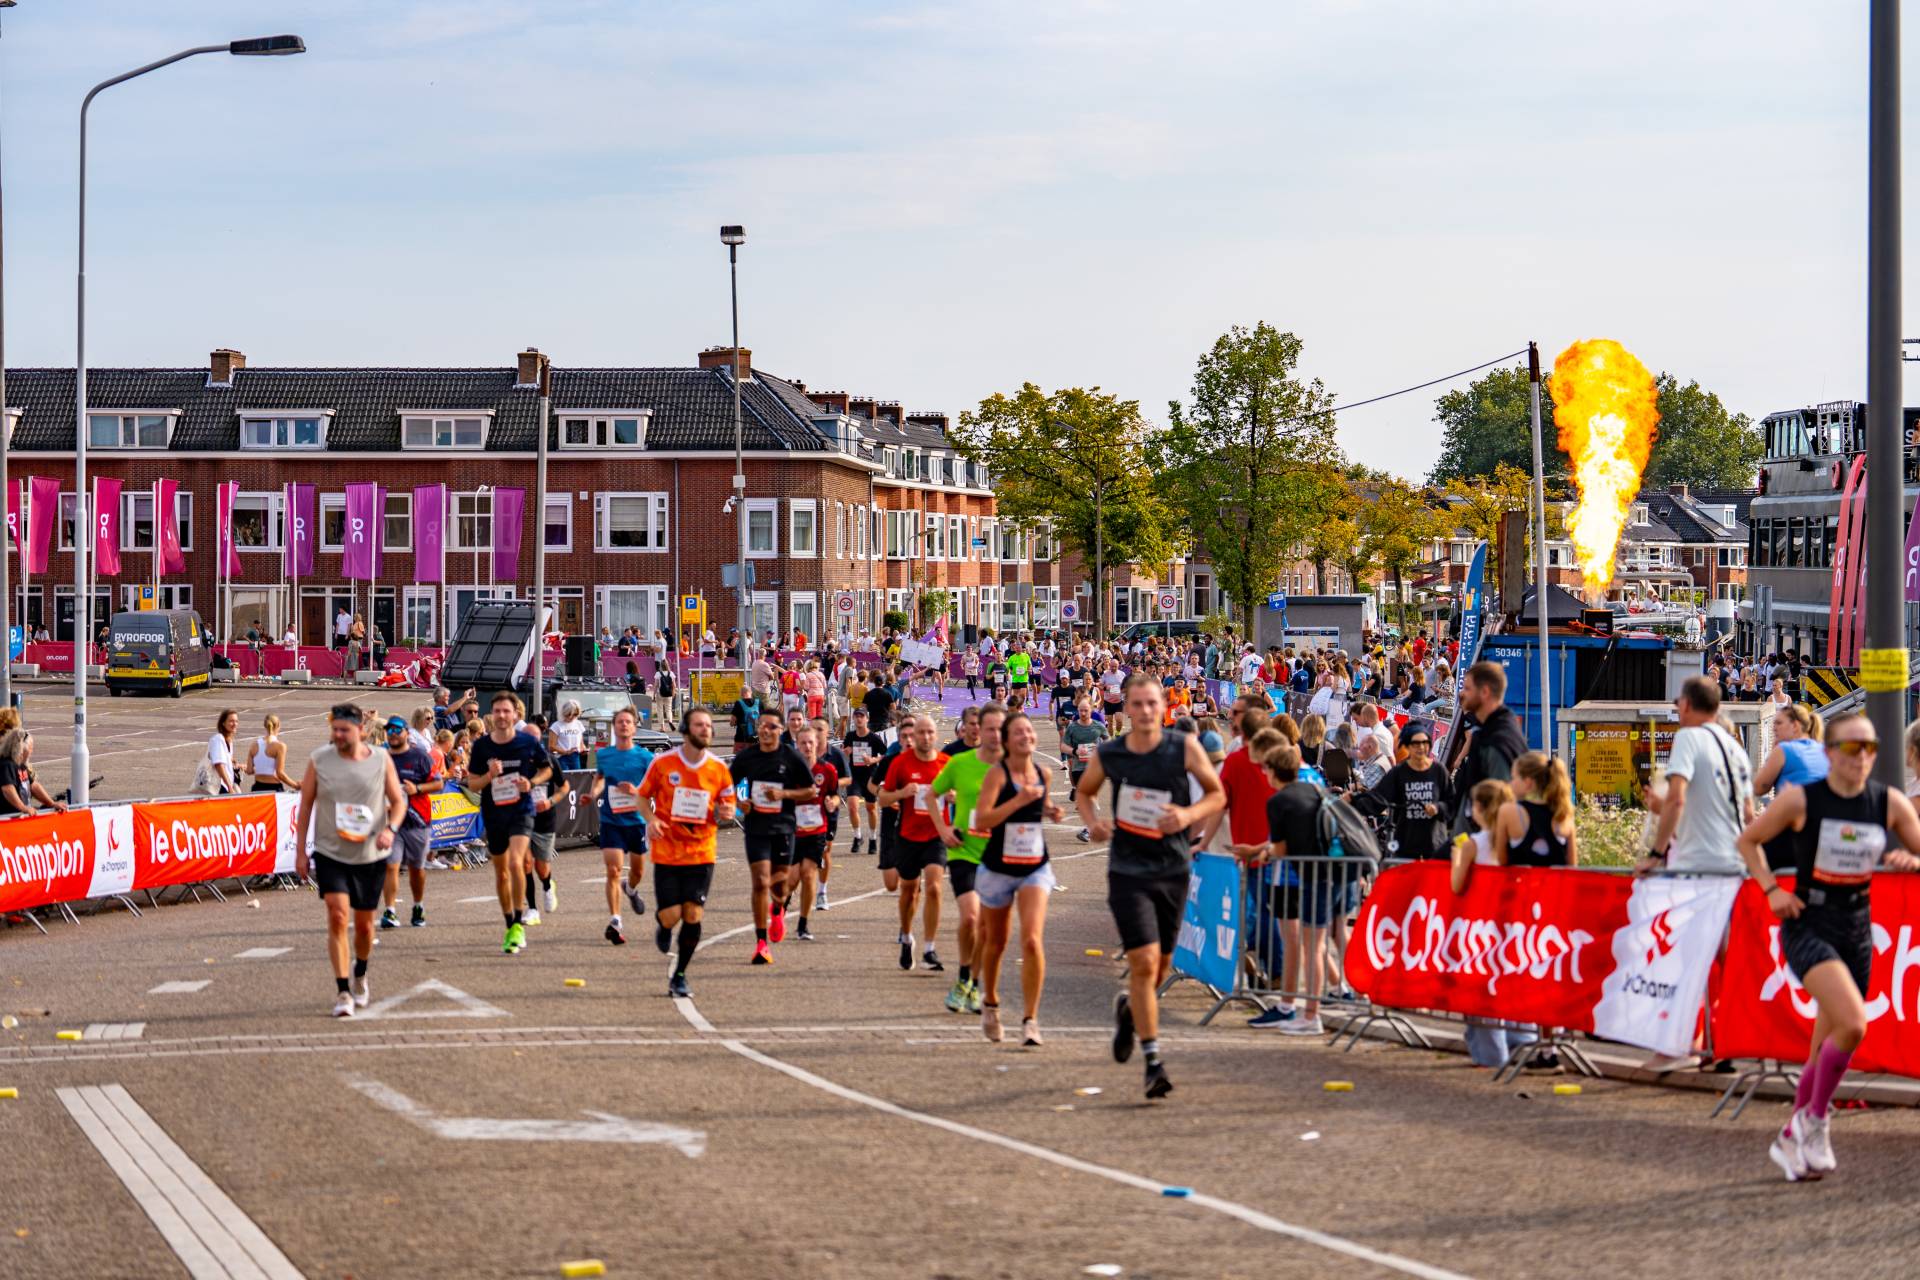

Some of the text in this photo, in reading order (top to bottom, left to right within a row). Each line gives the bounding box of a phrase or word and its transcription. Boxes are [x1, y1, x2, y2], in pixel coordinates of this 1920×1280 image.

[841, 600, 851, 608] 30
[1163, 598, 1173, 606] 30
[114, 632, 165, 643] PYROFOOR
[1495, 648, 1522, 657] 50346
[1405, 782, 1434, 791] LIGHT
[1405, 791, 1433, 800] YOUR
[149, 813, 267, 868] le Champion
[0, 830, 84, 893] hampion
[1366, 904, 1400, 971] le
